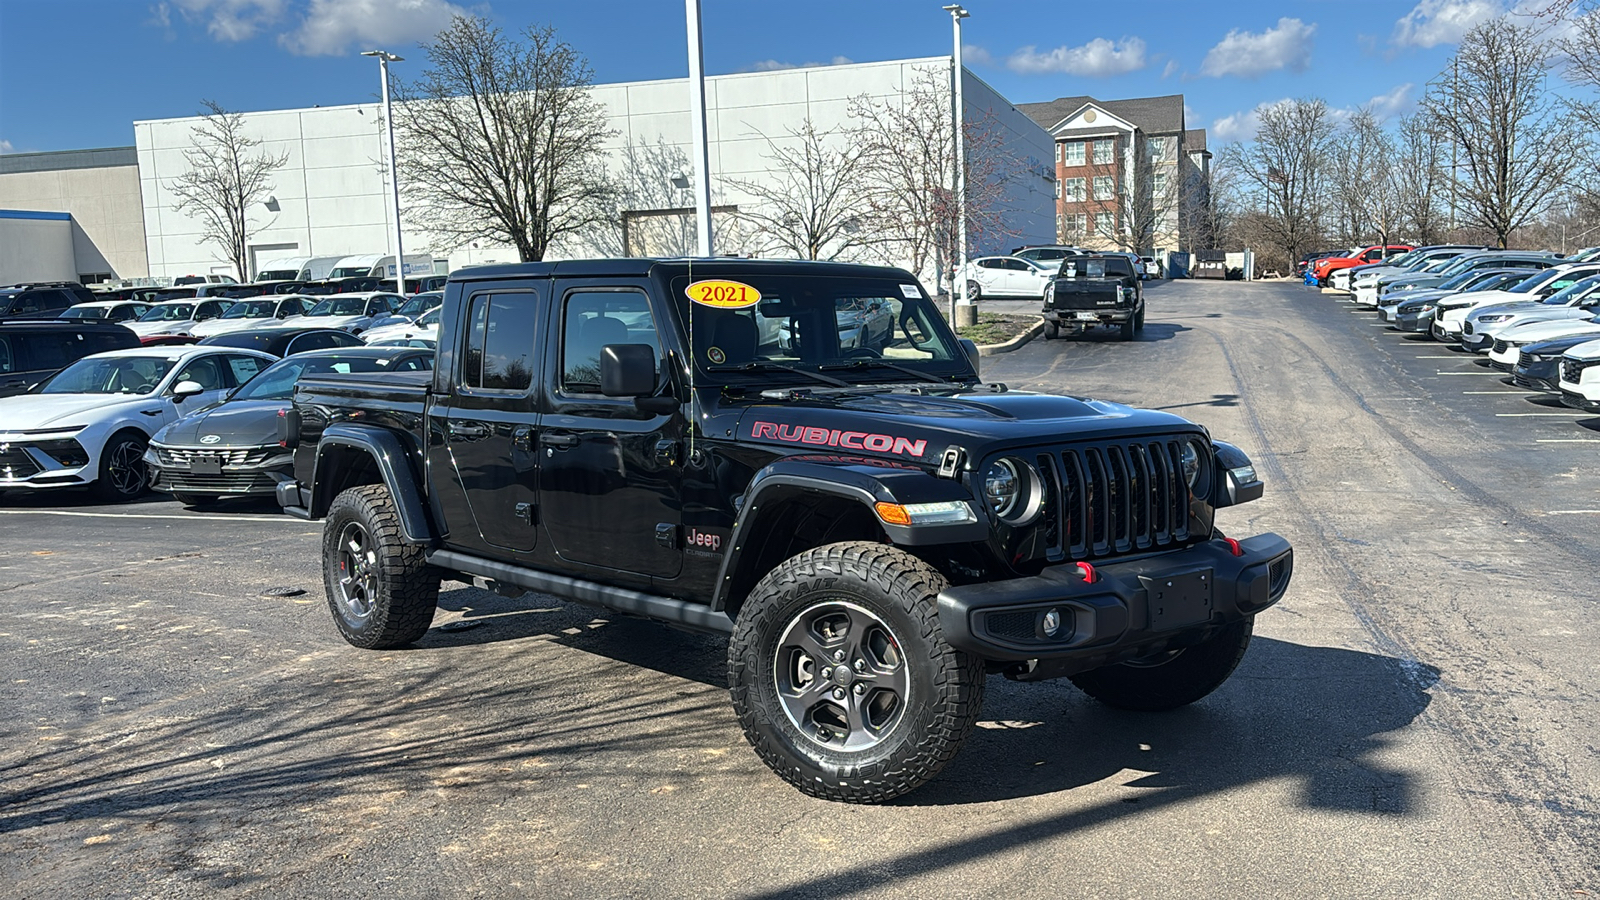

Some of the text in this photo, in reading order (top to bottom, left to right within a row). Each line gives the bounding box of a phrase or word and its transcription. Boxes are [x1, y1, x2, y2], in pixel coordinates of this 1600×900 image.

[701, 286, 748, 302] 2021
[751, 421, 927, 457] RUBICON
[687, 528, 721, 551] Jeep
[796, 577, 838, 596] A/T
